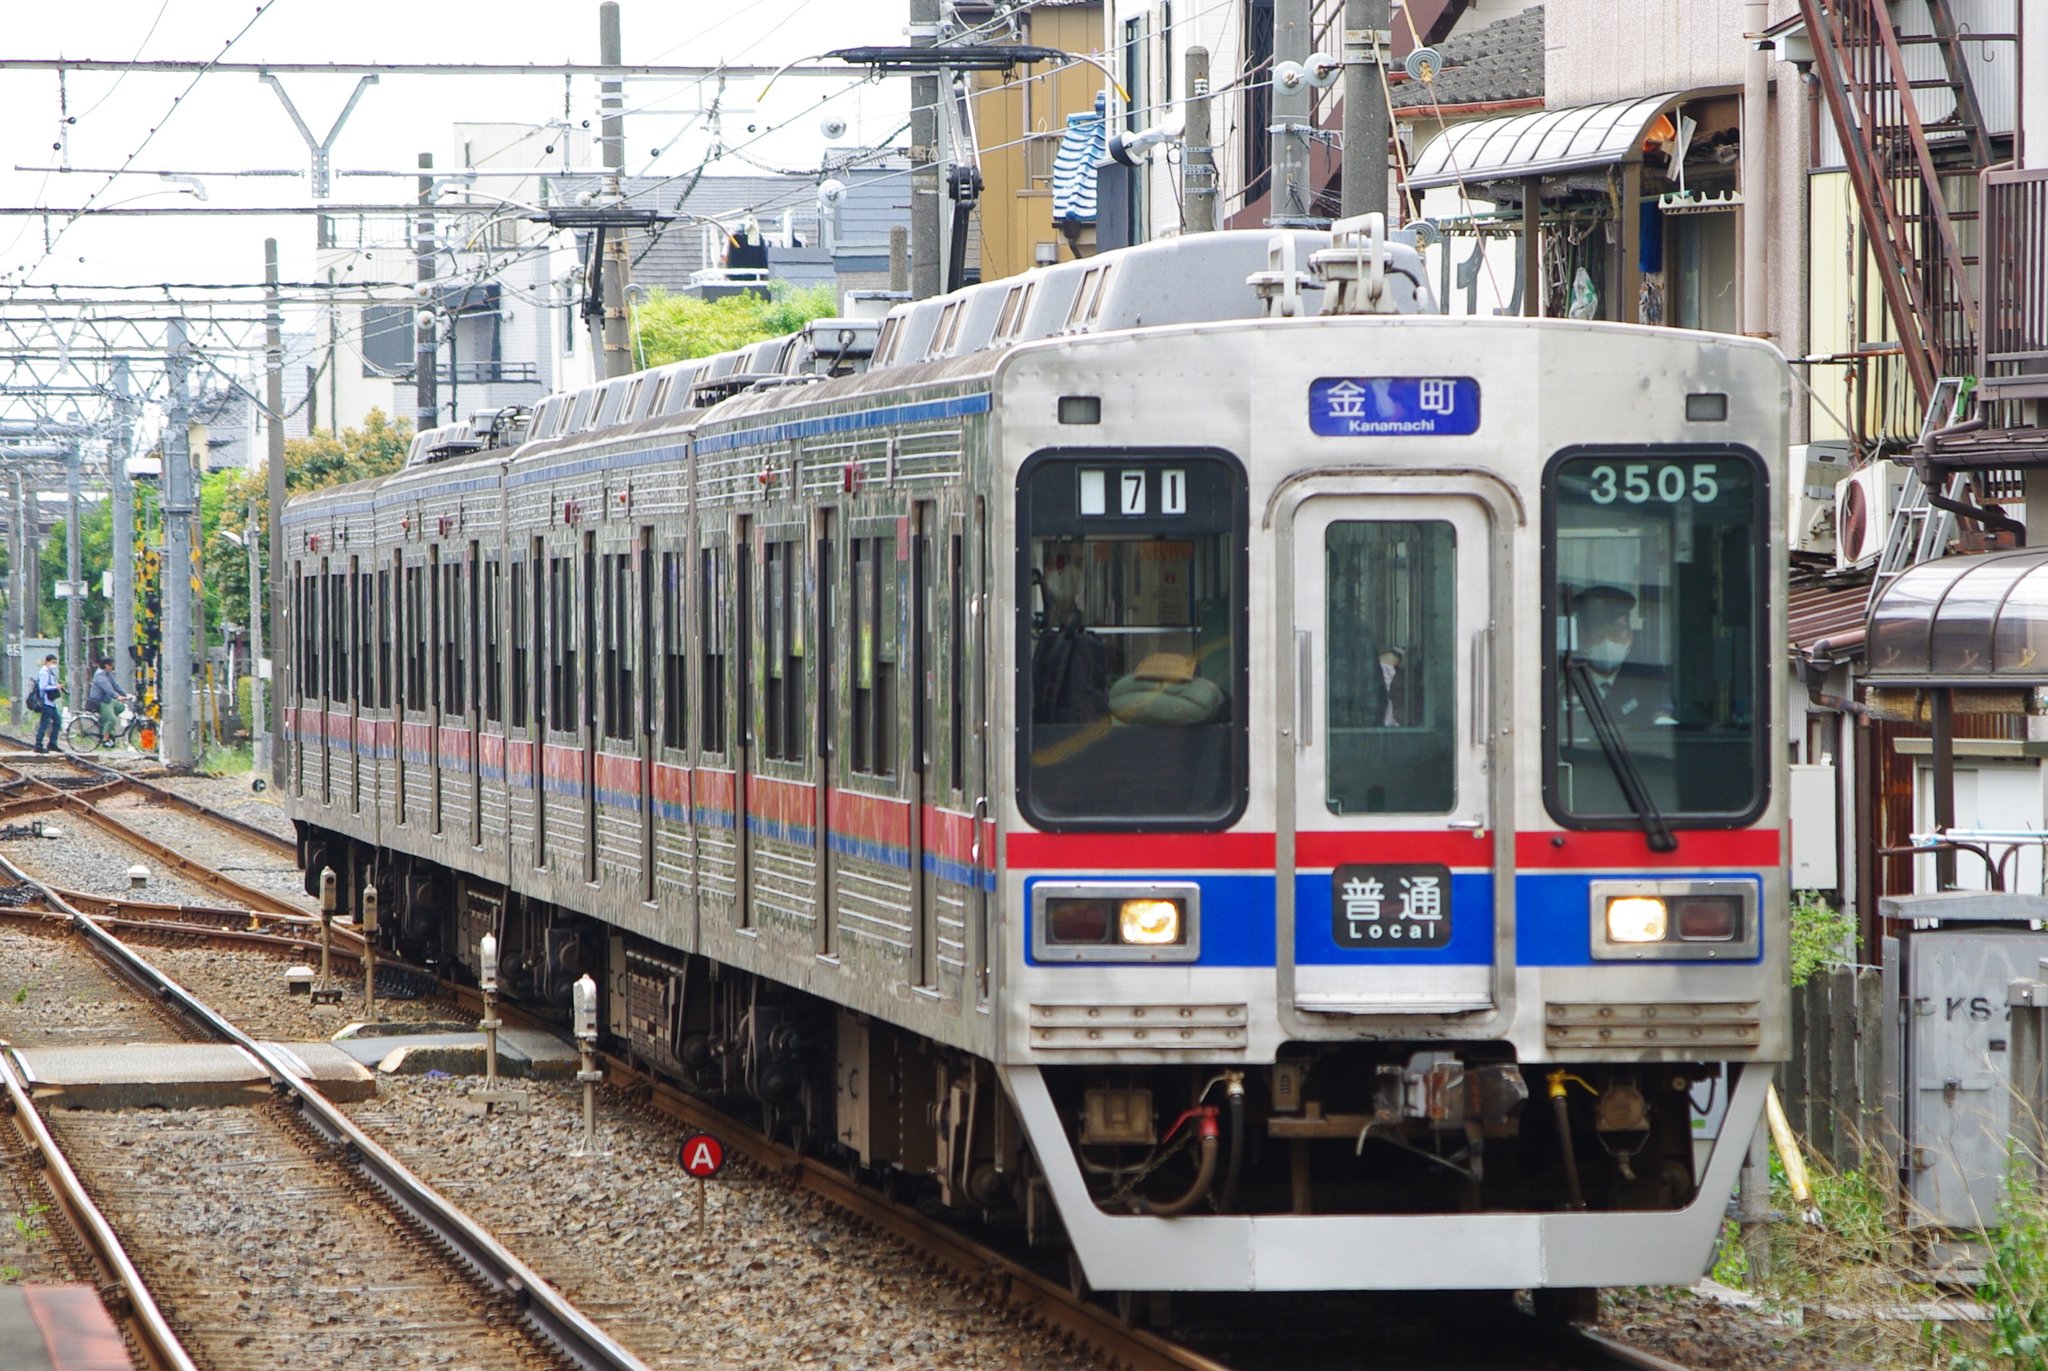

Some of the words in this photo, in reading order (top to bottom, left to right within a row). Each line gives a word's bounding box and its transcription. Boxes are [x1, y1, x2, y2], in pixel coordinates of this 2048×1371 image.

[1327, 379, 1457, 417] 金町
[1349, 419, 1435, 432] Kanamachi
[1590, 464, 1719, 504] 3505
[1341, 876, 1443, 920] 普通
[1349, 921, 1435, 939] Local
[690, 1142, 714, 1170] A
